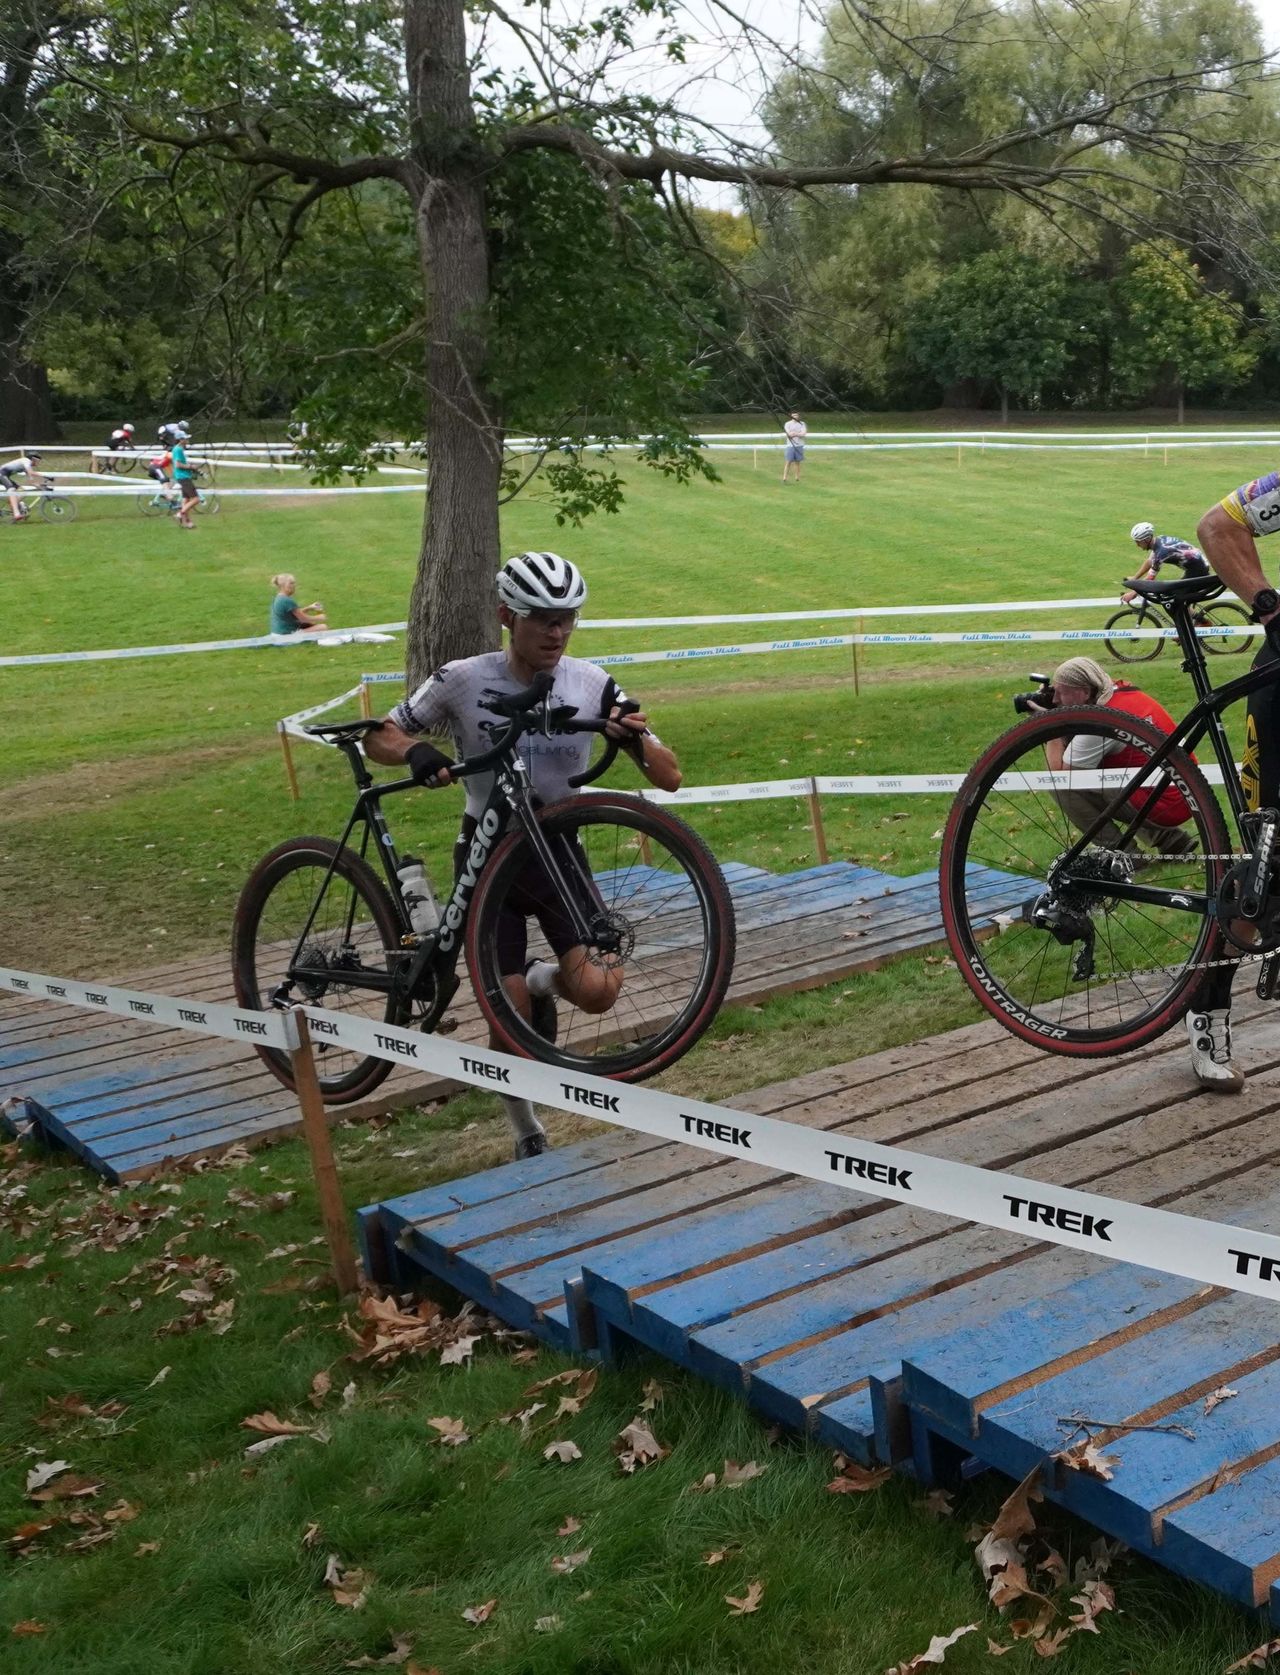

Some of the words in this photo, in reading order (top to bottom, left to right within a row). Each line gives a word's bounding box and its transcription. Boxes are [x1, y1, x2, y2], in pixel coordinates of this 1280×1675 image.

[1259, 504, 1280, 521] 3
[791, 640, 818, 648] Moon
[607, 655, 634, 663] Vista
[665, 651, 686, 659] Full
[687, 649, 714, 657] Moon
[715, 647, 741, 655] Vista
[1254, 823, 1275, 895] SRAM
[11, 978, 30, 990] TREK
[46, 984, 67, 997] TREK
[85, 992, 108, 1006] TREK
[128, 1000, 155, 1015] TREK
[178, 1009, 207, 1025] TREK
[233, 1018, 268, 1036] TREK
[374, 1034, 417, 1058] TREK
[459, 1057, 510, 1084] TREK
[560, 1083, 620, 1113] TREK
[680, 1114, 752, 1148] TREK
[825, 1151, 912, 1190] TREK
[1003, 1194, 1114, 1242] TREK
